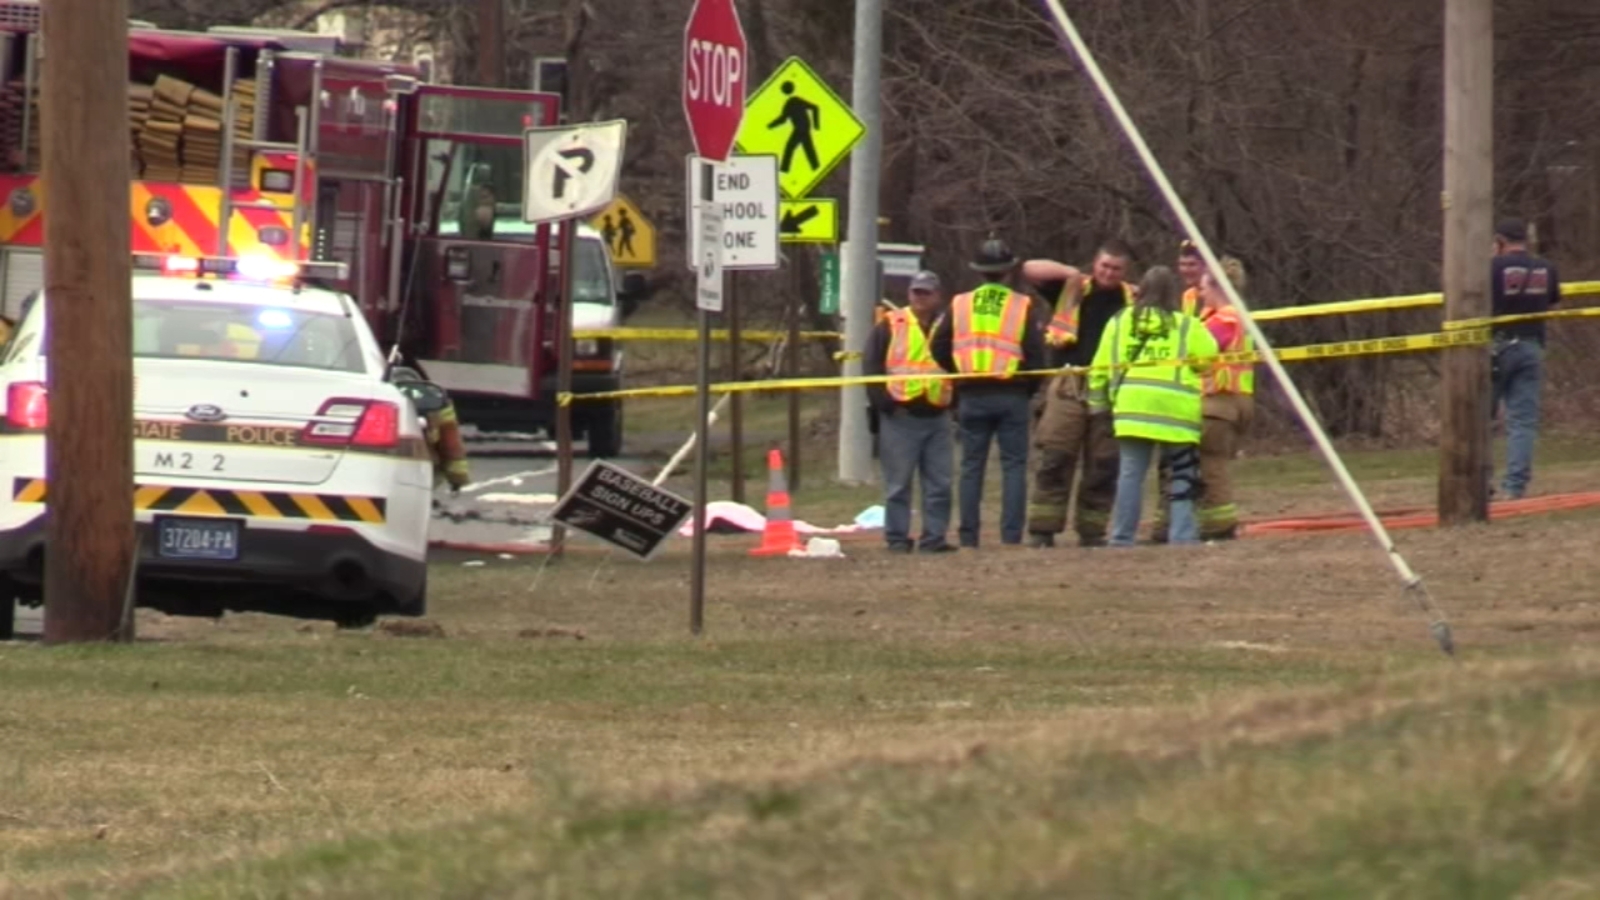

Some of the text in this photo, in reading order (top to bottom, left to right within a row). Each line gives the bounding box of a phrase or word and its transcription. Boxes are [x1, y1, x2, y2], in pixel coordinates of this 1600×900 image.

[688, 38, 741, 108] STOP
[717, 173, 750, 190] END
[722, 202, 767, 219] HOOL
[723, 231, 757, 248] ONE
[226, 426, 296, 446] POLICE
[597, 468, 680, 515] BASEBALL
[590, 484, 666, 526] SIGN UPS
